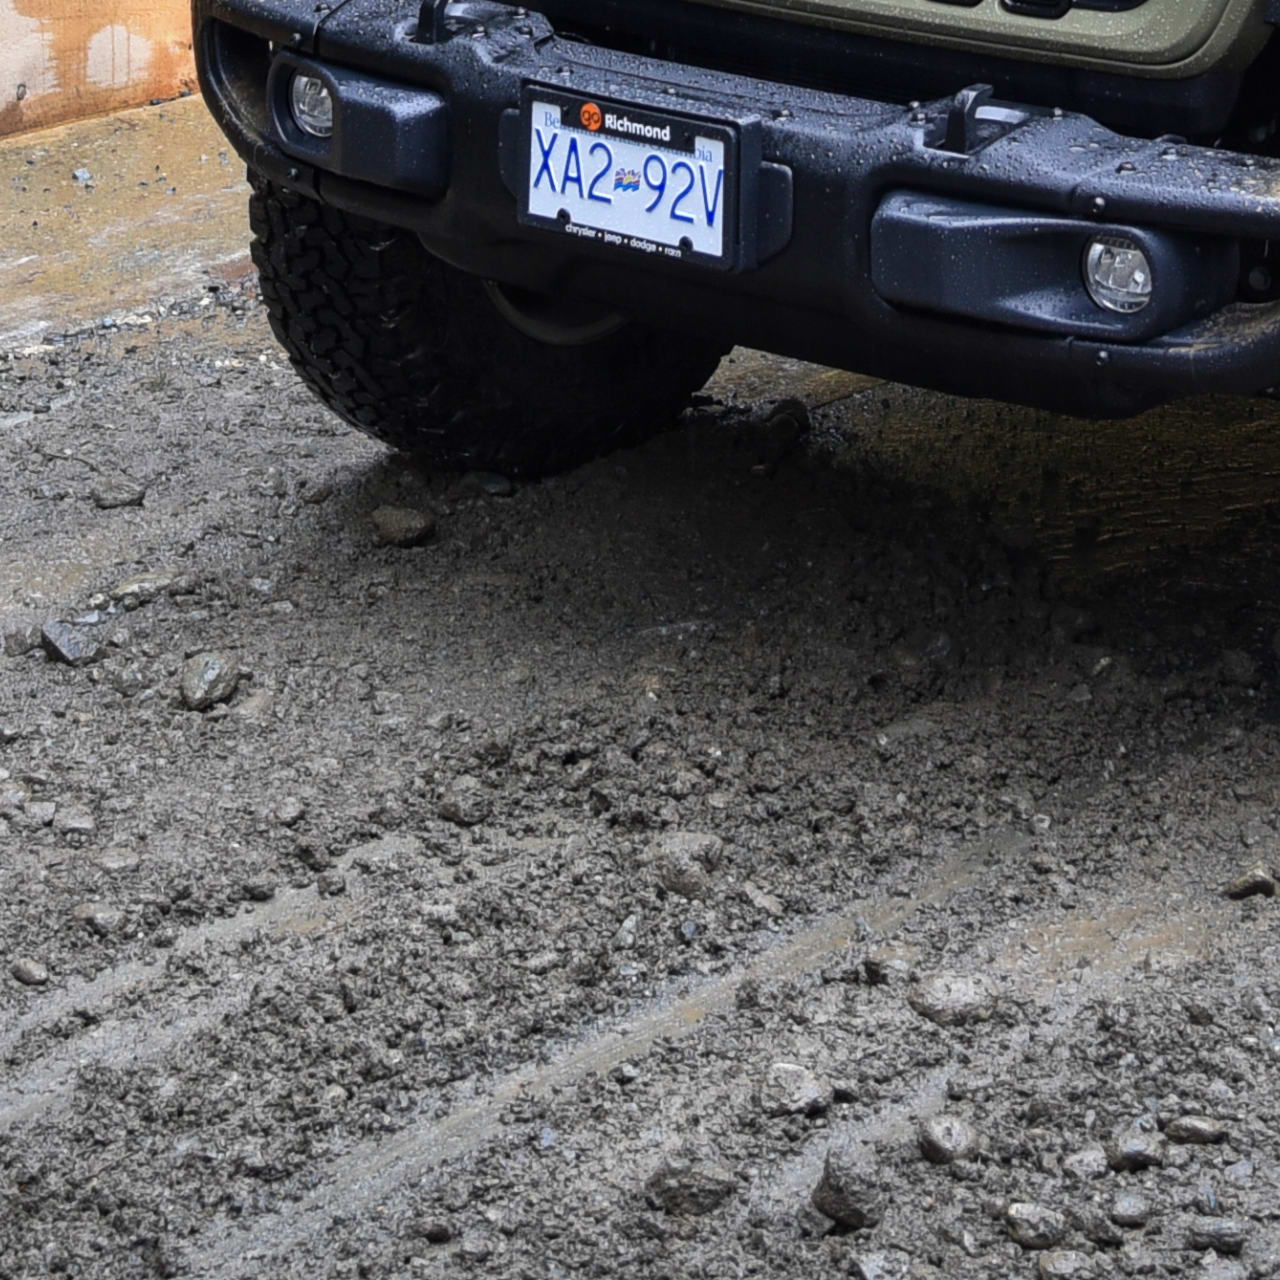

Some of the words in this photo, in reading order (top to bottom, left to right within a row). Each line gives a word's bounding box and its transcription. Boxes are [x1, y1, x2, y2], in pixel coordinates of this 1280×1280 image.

[581, 107, 601, 128] go
[604, 113, 670, 141] Richmond
[533, 127, 613, 204] XA2
[642, 153, 724, 228] 92V
[565, 224, 596, 237] chrysler
[604, 231, 623, 245] jeep
[629, 238, 657, 253] dodge
[664, 247, 682, 258] ram
